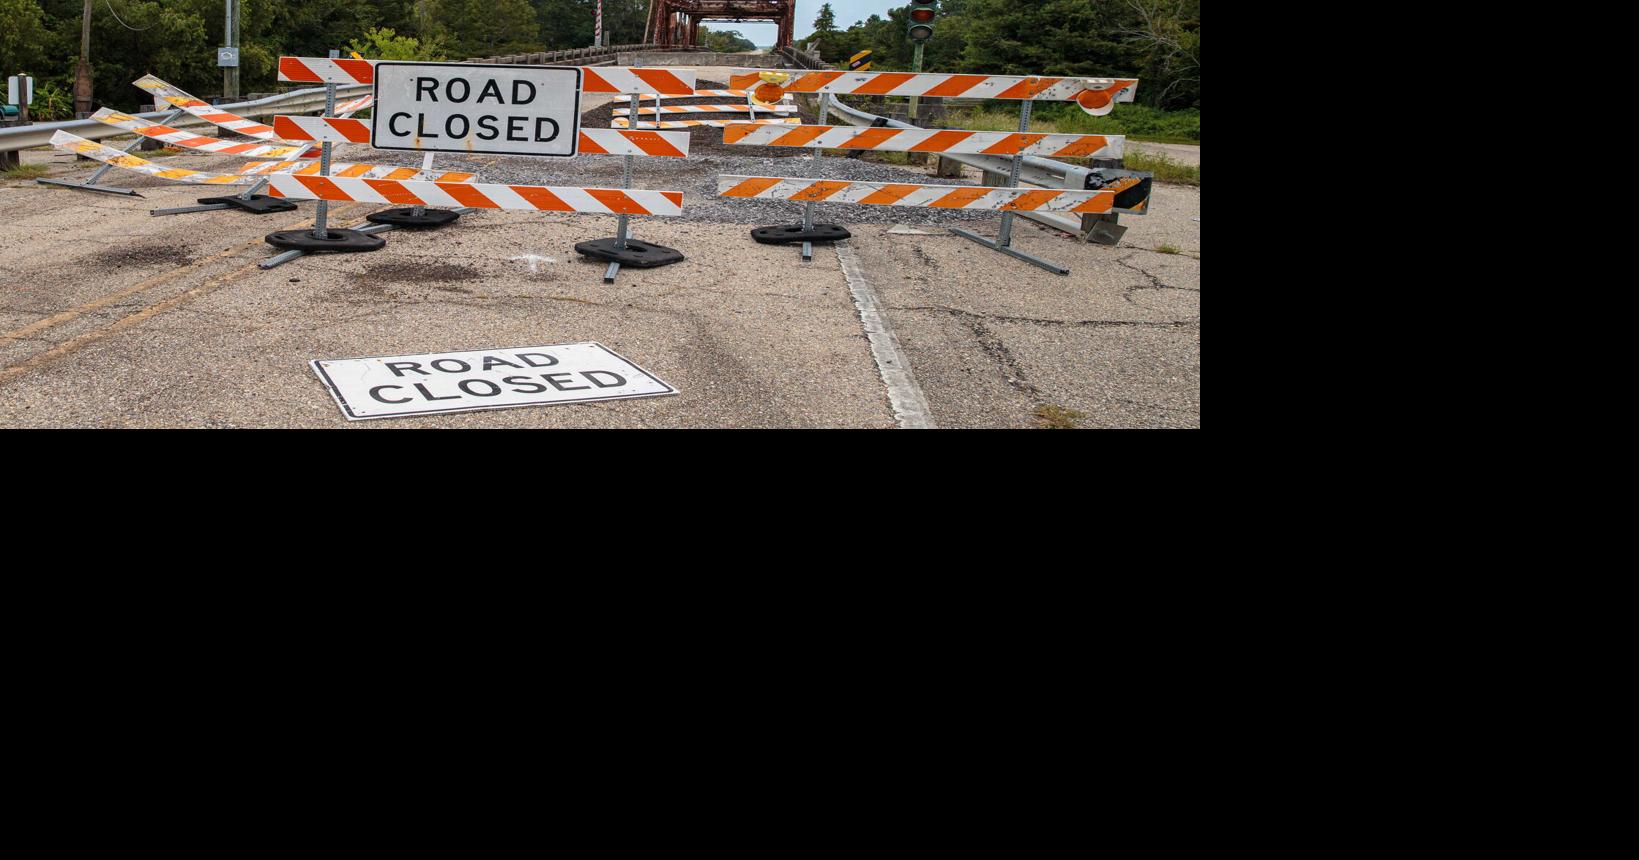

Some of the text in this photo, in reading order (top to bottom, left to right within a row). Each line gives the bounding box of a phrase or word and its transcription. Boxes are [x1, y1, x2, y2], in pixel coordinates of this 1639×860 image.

[415, 76, 537, 105] ROAD
[388, 111, 560, 143] CLOSED
[386, 352, 560, 377] ROAD
[369, 370, 627, 404] CLOSED
